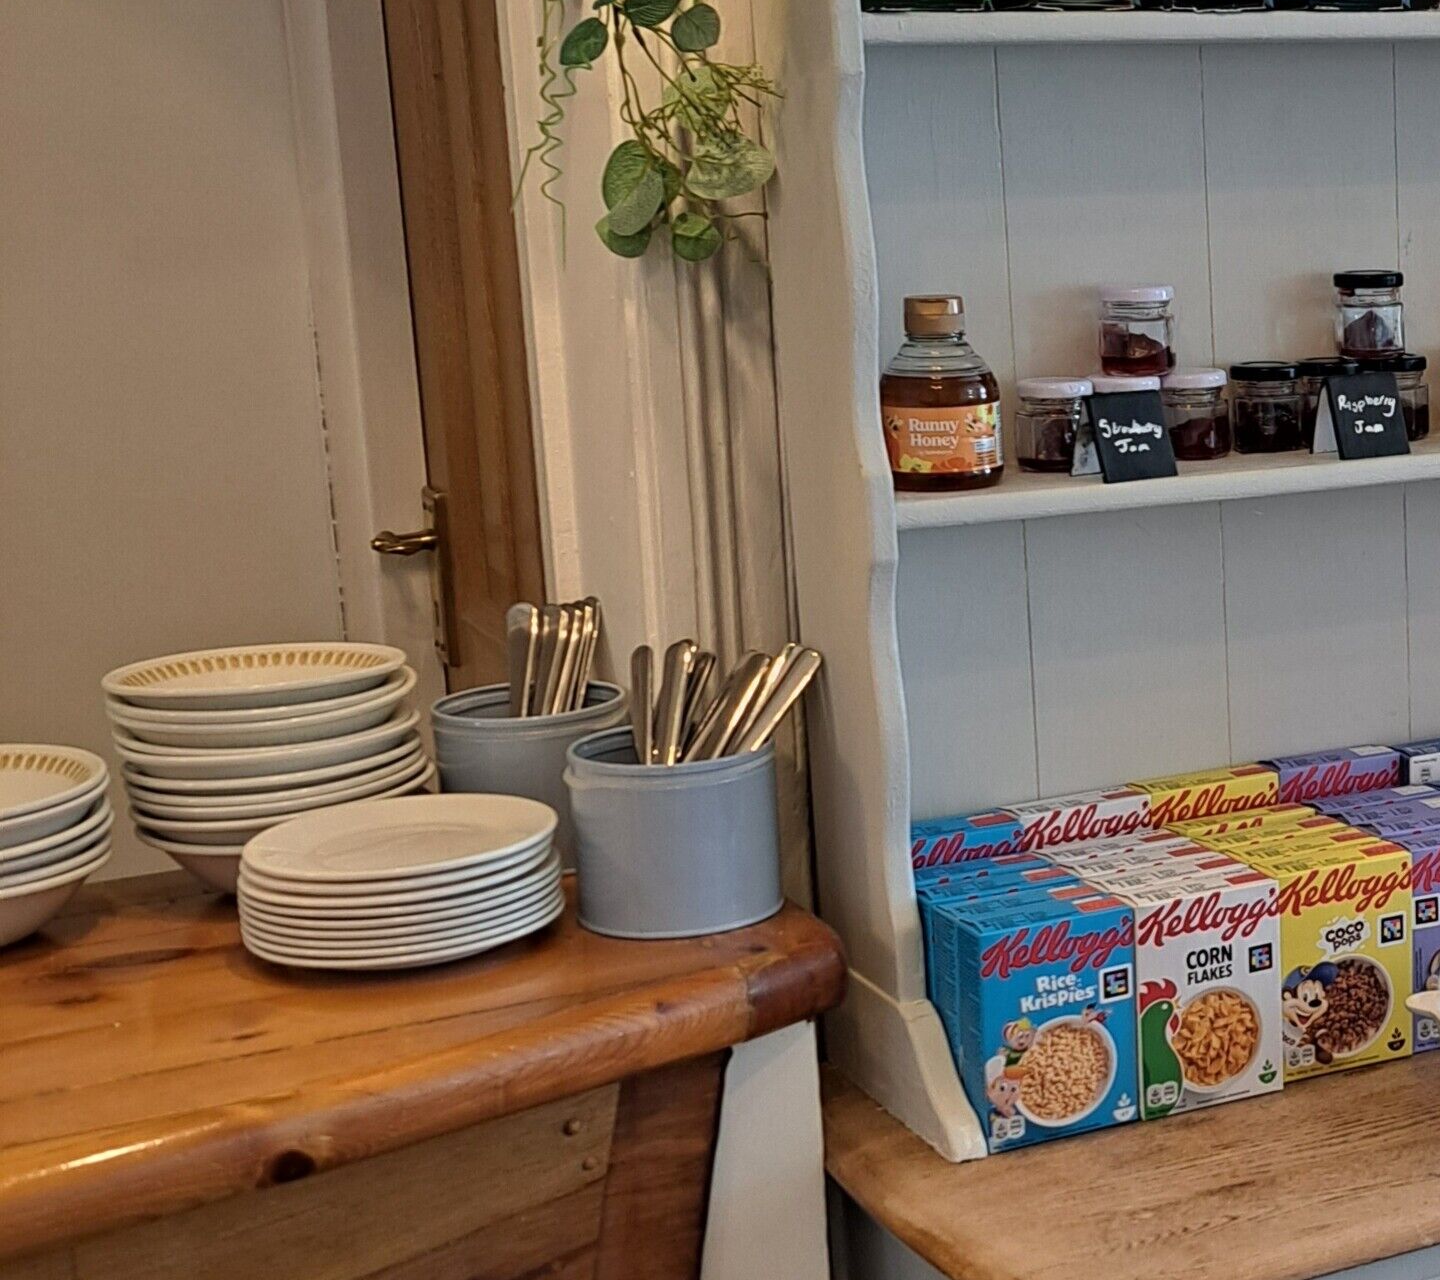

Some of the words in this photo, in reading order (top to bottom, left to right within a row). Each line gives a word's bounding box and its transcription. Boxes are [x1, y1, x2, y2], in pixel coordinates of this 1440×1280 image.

[1337, 393, 1397, 418] Raspberry
[908, 417, 961, 434] Runny
[1353, 420, 1385, 434] Jam
[910, 433, 960, 450] Honey
[1278, 861, 1412, 917] Kellogg's
[1137, 886, 1281, 947] Kellogg's
[980, 915, 1136, 979] Kellogg's
[1332, 932, 1362, 953] pops
[1186, 943, 1234, 970] CORN
[1035, 972, 1077, 993] Rice
[1186, 963, 1233, 986] FLAKES
[1019, 984, 1098, 1014] Krispies
